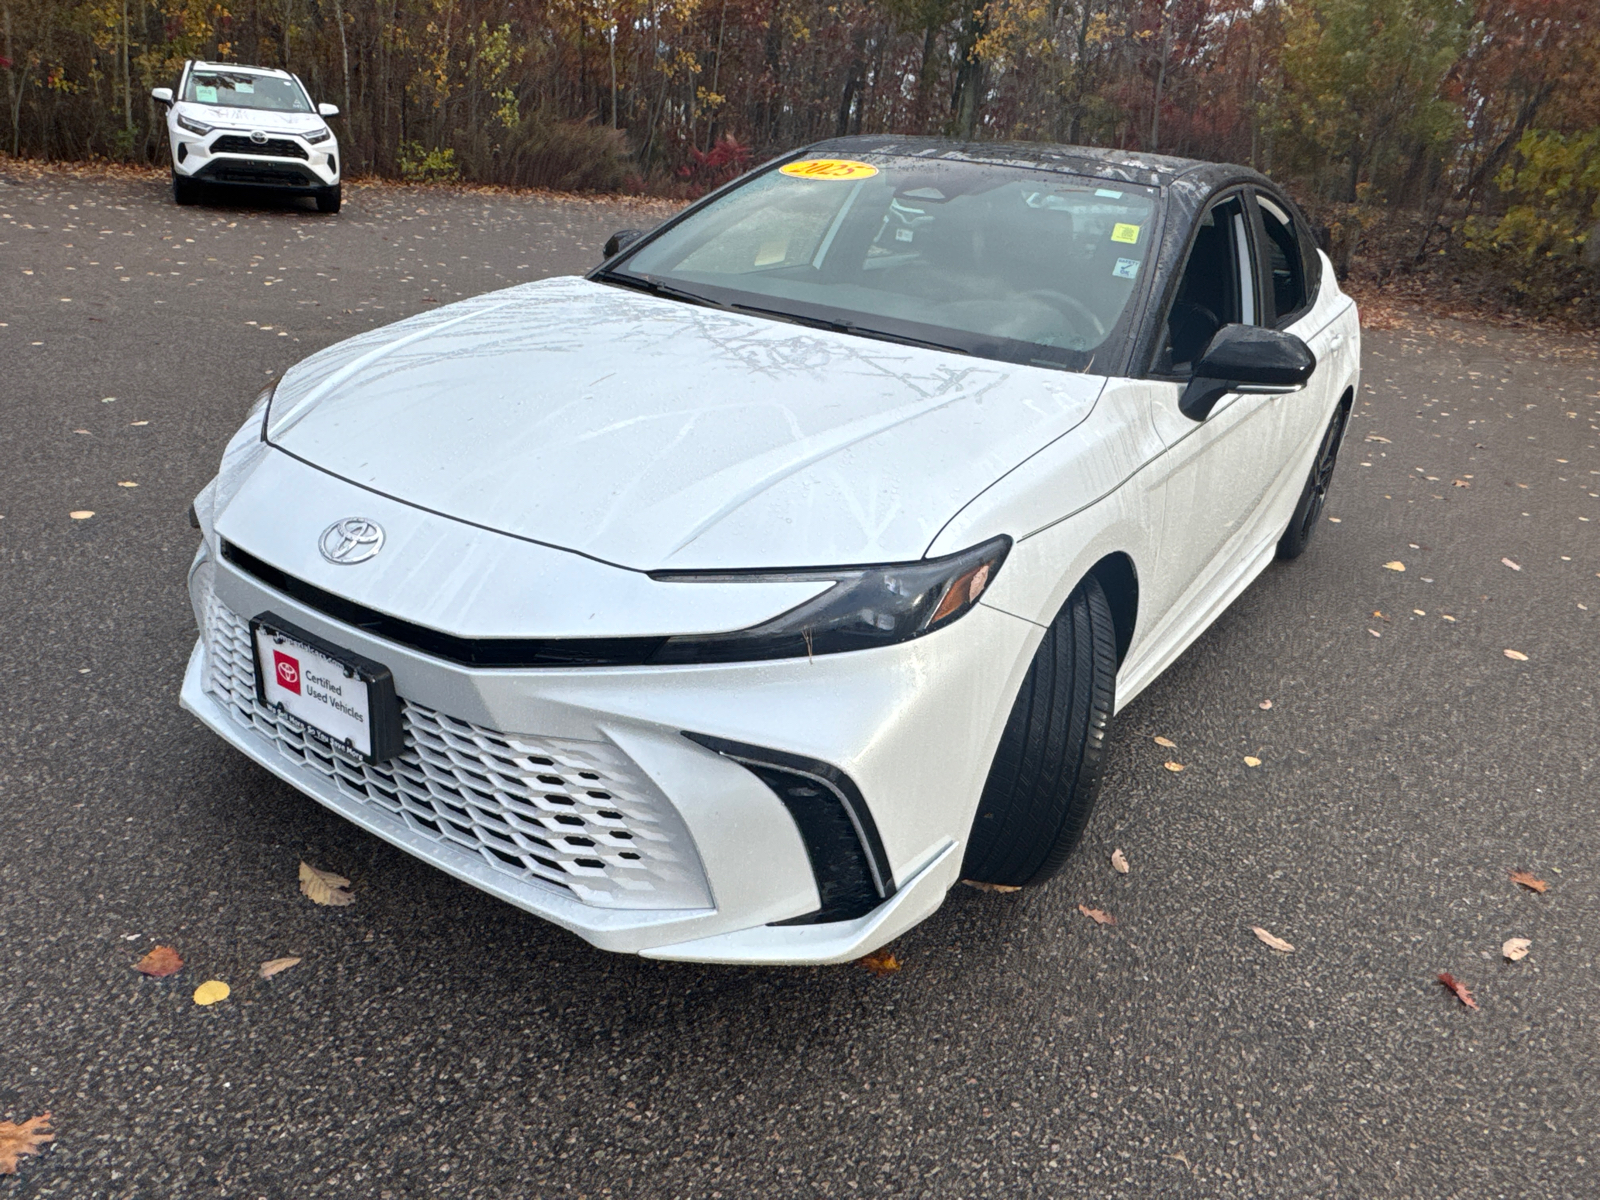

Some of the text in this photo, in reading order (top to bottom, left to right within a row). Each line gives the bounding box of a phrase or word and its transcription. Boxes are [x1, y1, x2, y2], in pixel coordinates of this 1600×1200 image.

[789, 162, 866, 176] 2025
[305, 670, 342, 696] Certified
[306, 684, 364, 723] Used Vehicles
[316, 730, 329, 743] You
[346, 745, 363, 761] More
